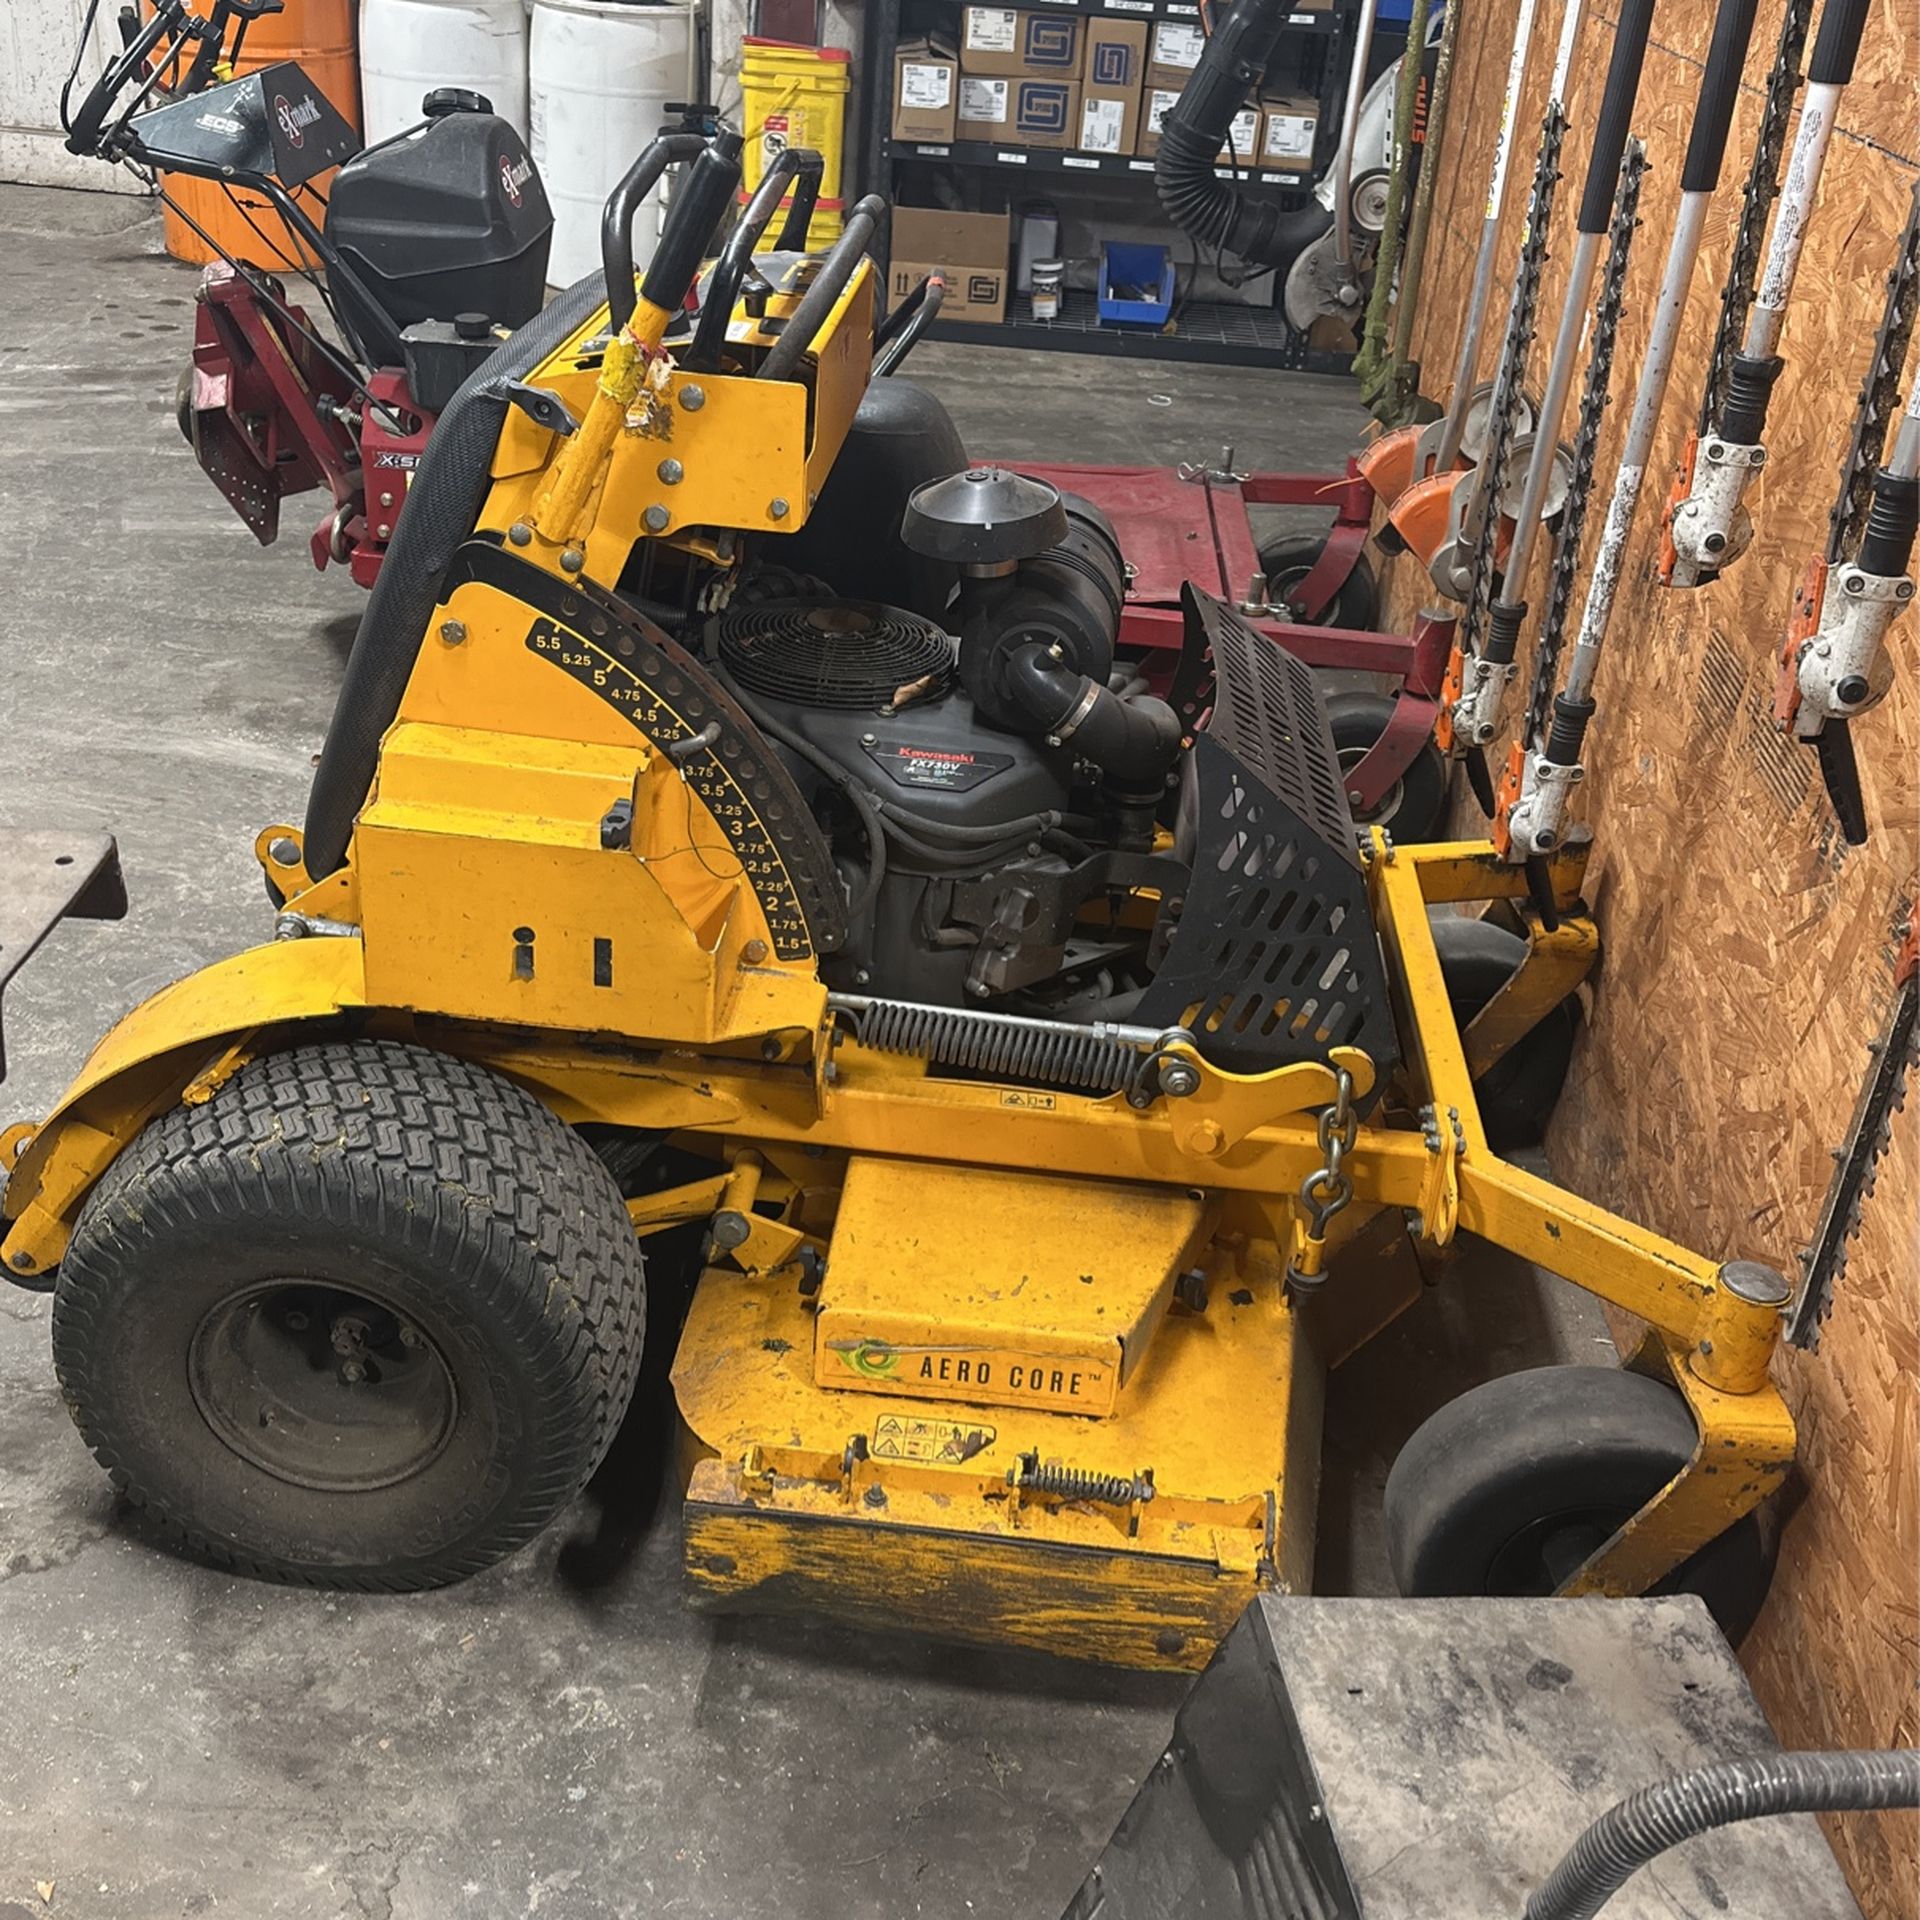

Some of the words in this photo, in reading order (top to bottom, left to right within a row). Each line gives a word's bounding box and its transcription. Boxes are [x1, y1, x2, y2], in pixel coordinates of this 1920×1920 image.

[1411, 75, 1427, 144] STIHL
[536, 635, 561, 650] 5.5
[562, 653, 591, 666] 5.25
[593, 670, 607, 686] 5
[611, 688, 641, 701] 4.75
[632, 708, 658, 722] 4.5
[651, 727, 680, 740] 4.25
[898, 747, 976, 765] Kawasaki
[686, 765, 714, 778] 3.75
[909, 758, 961, 772] FX730V
[700, 783, 725, 797] 3.5
[714, 803, 742, 816] 3.25
[730, 820, 744, 836] 3
[737, 842, 765, 855] 2.75
[747, 860, 771, 874] 2.5
[756, 880, 784, 893] 2.25
[766, 897, 779, 911] 2
[770, 918, 798, 930] 1.75
[776, 936, 800, 949] 1.5
[919, 1356, 990, 1384] AERO
